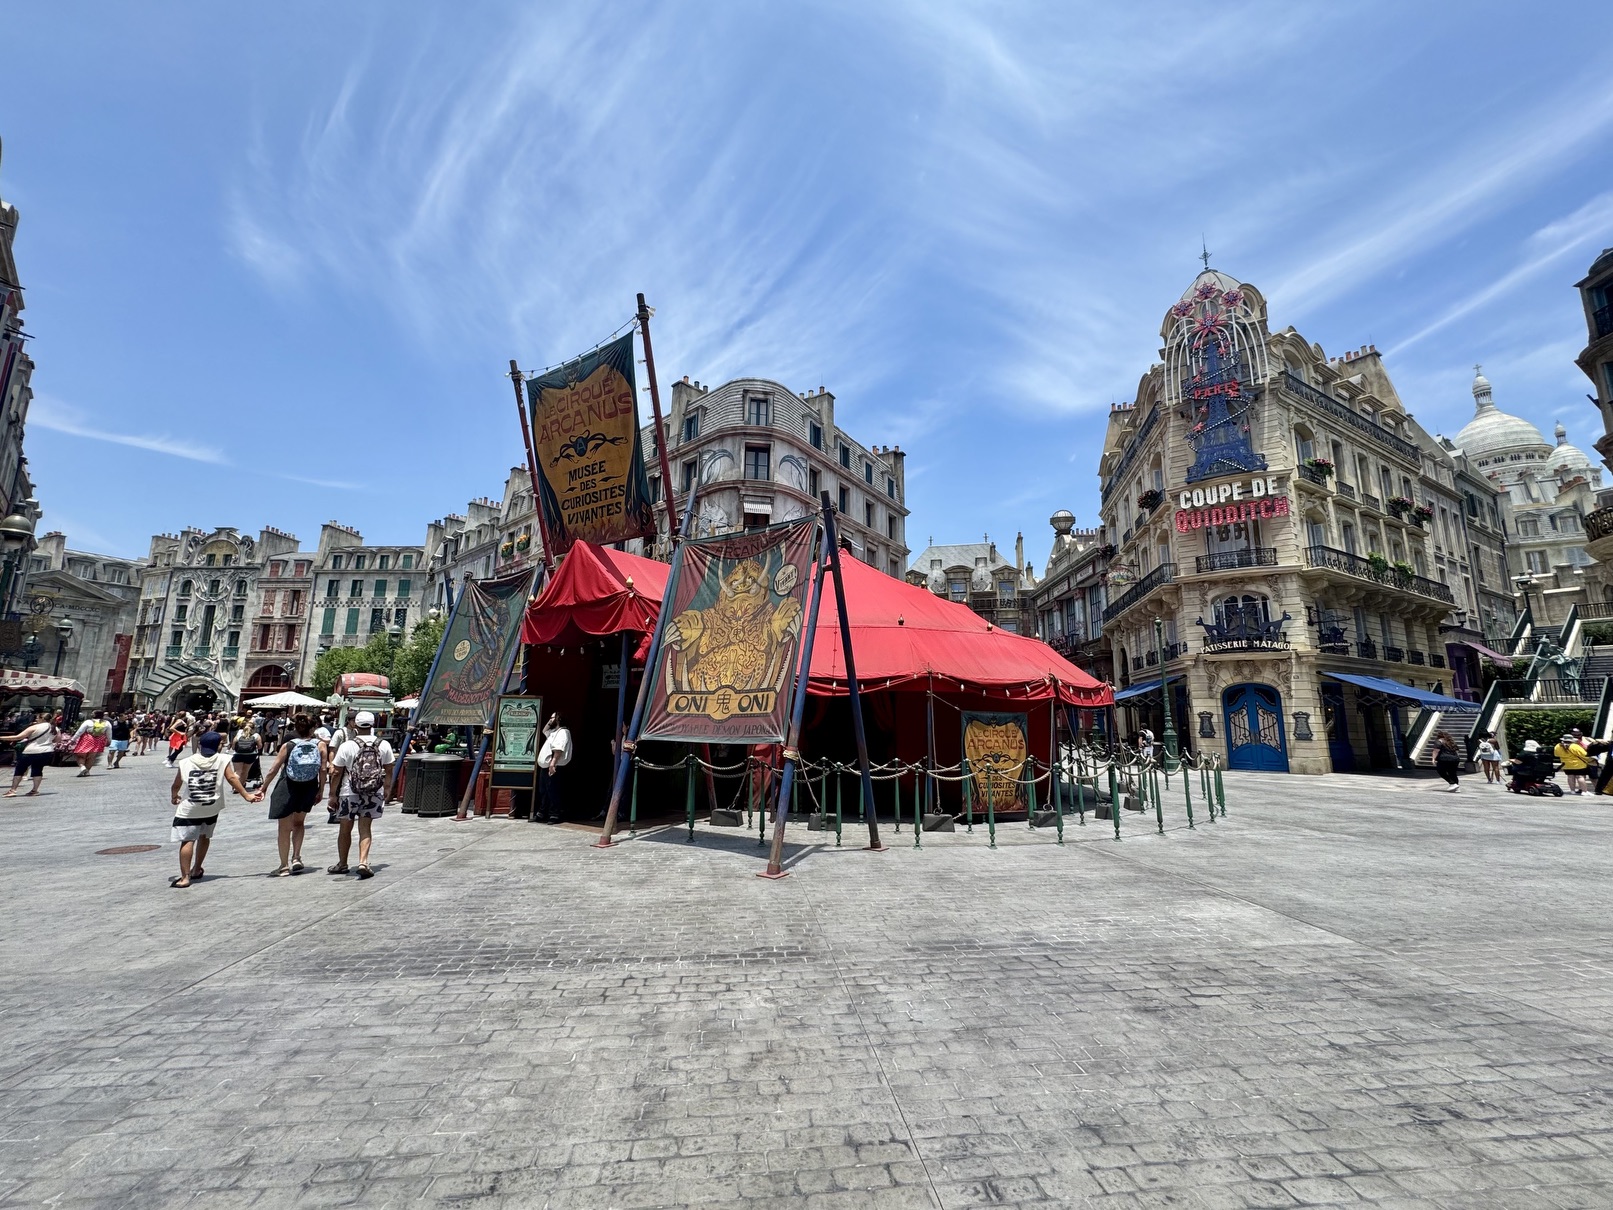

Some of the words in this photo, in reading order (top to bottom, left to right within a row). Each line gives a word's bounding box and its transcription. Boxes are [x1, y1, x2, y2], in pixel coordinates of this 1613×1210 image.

[556, 377, 615, 414] CIRQUE
[1194, 380, 1239, 399] PARIS
[538, 391, 632, 444] ARCANUS
[568, 460, 606, 486] MUSÉE
[561, 482, 625, 511] CURIOSITÉS
[580, 479, 597, 492] DES
[1180, 481, 1243, 509] COUPE
[1252, 476, 1279, 497] DE
[567, 501, 622, 526] VIVANTES
[1175, 496, 1289, 533] QUIDDITCH
[716, 536, 777, 557] ARCANUS
[1200, 640, 1248, 653] PATISSERIE
[1253, 640, 1293, 651] MATAGOT
[675, 695, 708, 712] ONI
[738, 694, 770, 712] ONI
[967, 739, 1025, 750] ARCANUS
[981, 789, 1013, 798] VIANTES
